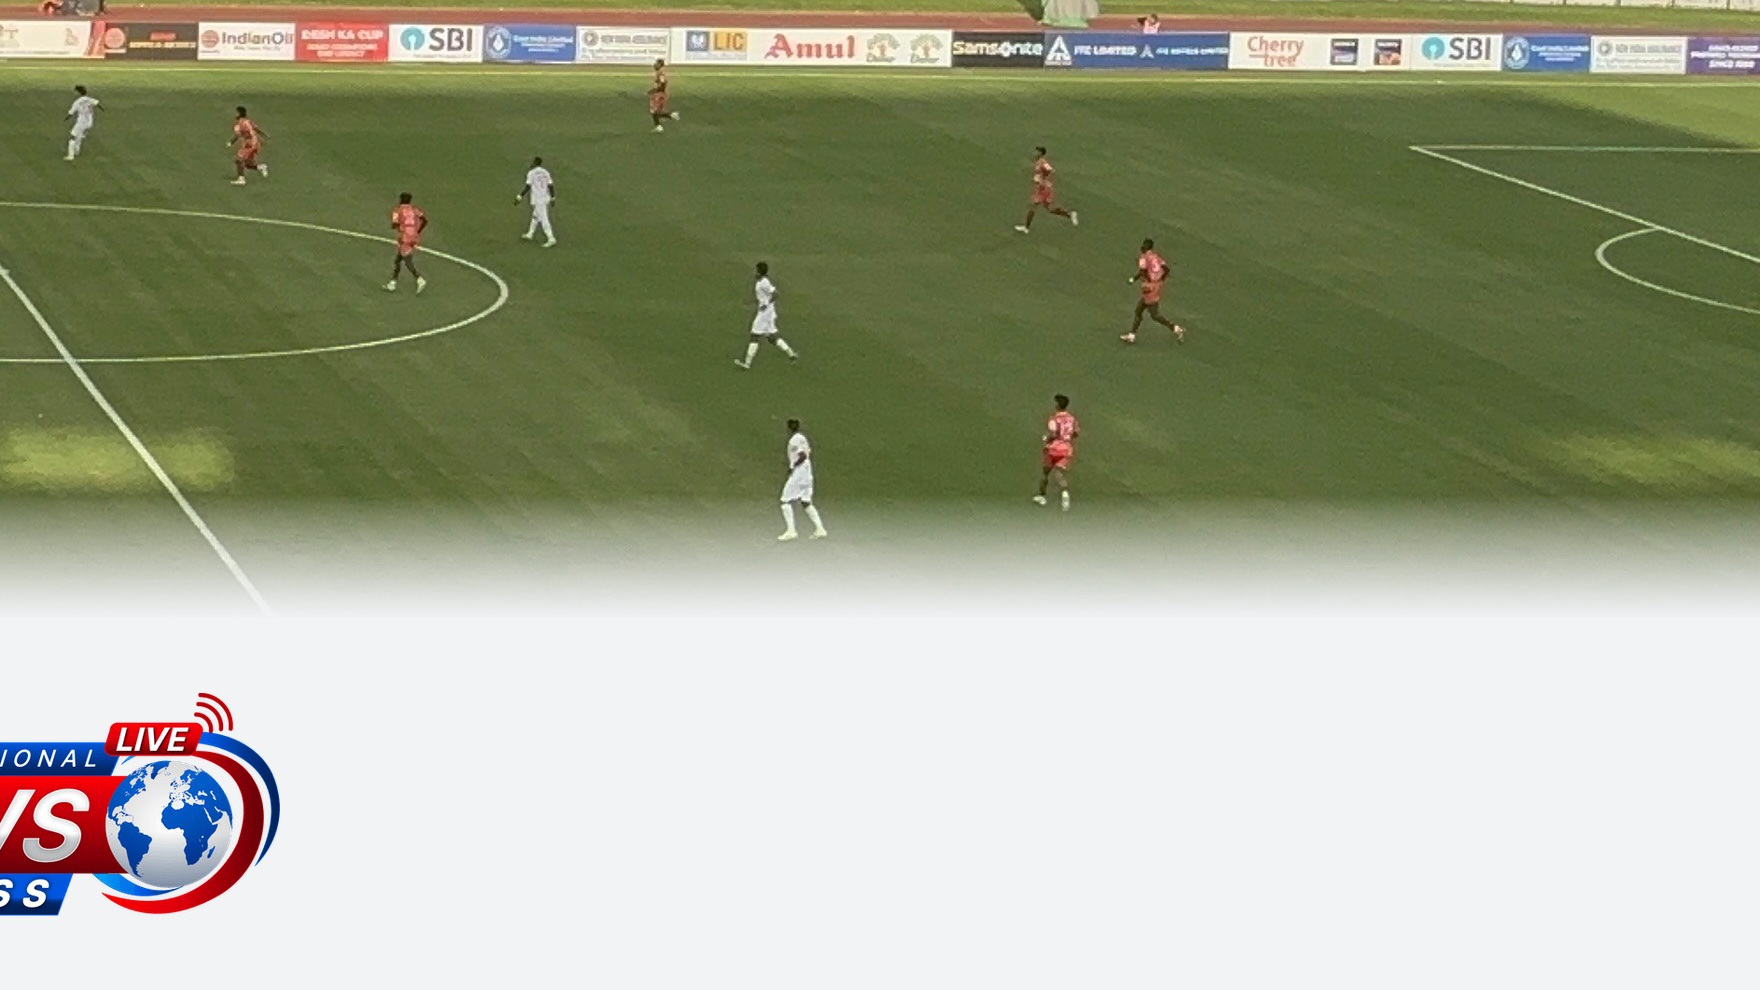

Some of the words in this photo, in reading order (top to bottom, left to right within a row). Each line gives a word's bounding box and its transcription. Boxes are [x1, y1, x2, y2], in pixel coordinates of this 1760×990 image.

[221, 31, 294, 46] IndianOil
[357, 29, 384, 41] CUP
[428, 28, 473, 51] SBI
[713, 32, 744, 51] LIC
[764, 33, 856, 60] Amul
[1093, 45, 1137, 57] LIMITED
[1247, 35, 1304, 58] Cherry
[1448, 37, 1491, 61] SBI
[1263, 54, 1297, 68] tree
